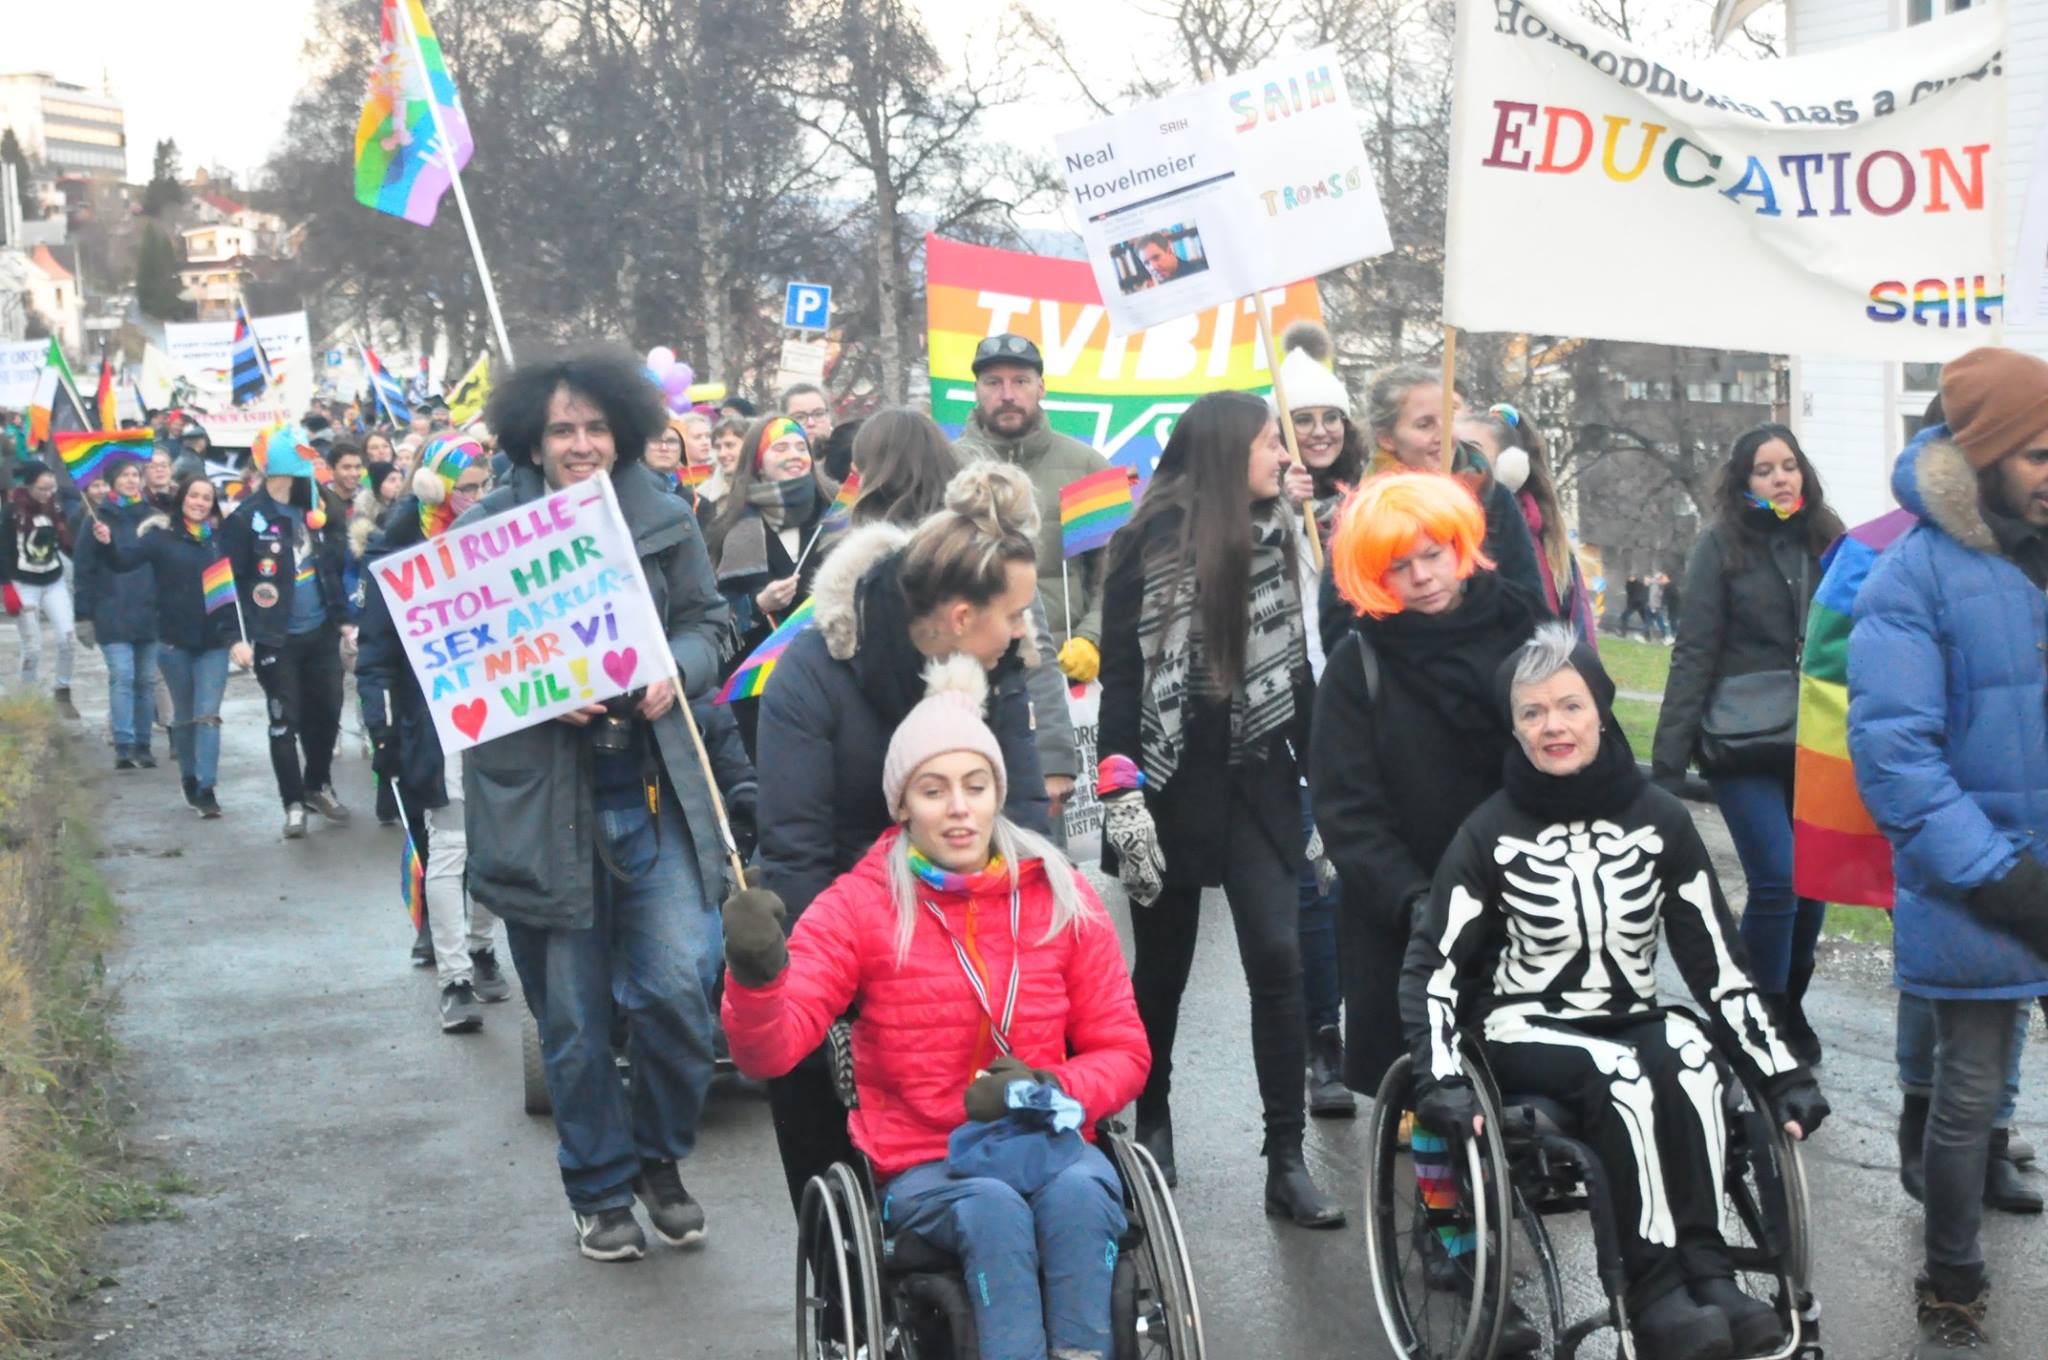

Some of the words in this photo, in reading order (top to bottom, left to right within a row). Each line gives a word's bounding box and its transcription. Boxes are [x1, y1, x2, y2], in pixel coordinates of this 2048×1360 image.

[1159, 118, 1189, 135] SAIH
[1229, 65, 1337, 134] SAIH
[1770, 100, 1860, 125] has
[1872, 89, 1896, 118] a
[1065, 143, 1116, 173] Neal
[1074, 152, 1198, 205] Hovelmeier
[1482, 100, 1991, 217] EDUCATION
[796, 288, 821, 324] P
[977, 290, 1286, 380] TVIBIT
[381, 553, 435, 602] VI
[459, 495, 602, 570] RULLE-
[405, 585, 513, 638] STOL
[511, 535, 604, 596] HAR
[423, 623, 497, 670] SEX
[506, 567, 635, 639] AKKUR-
[432, 662, 476, 700] AT
[484, 632, 566, 682] NÅR
